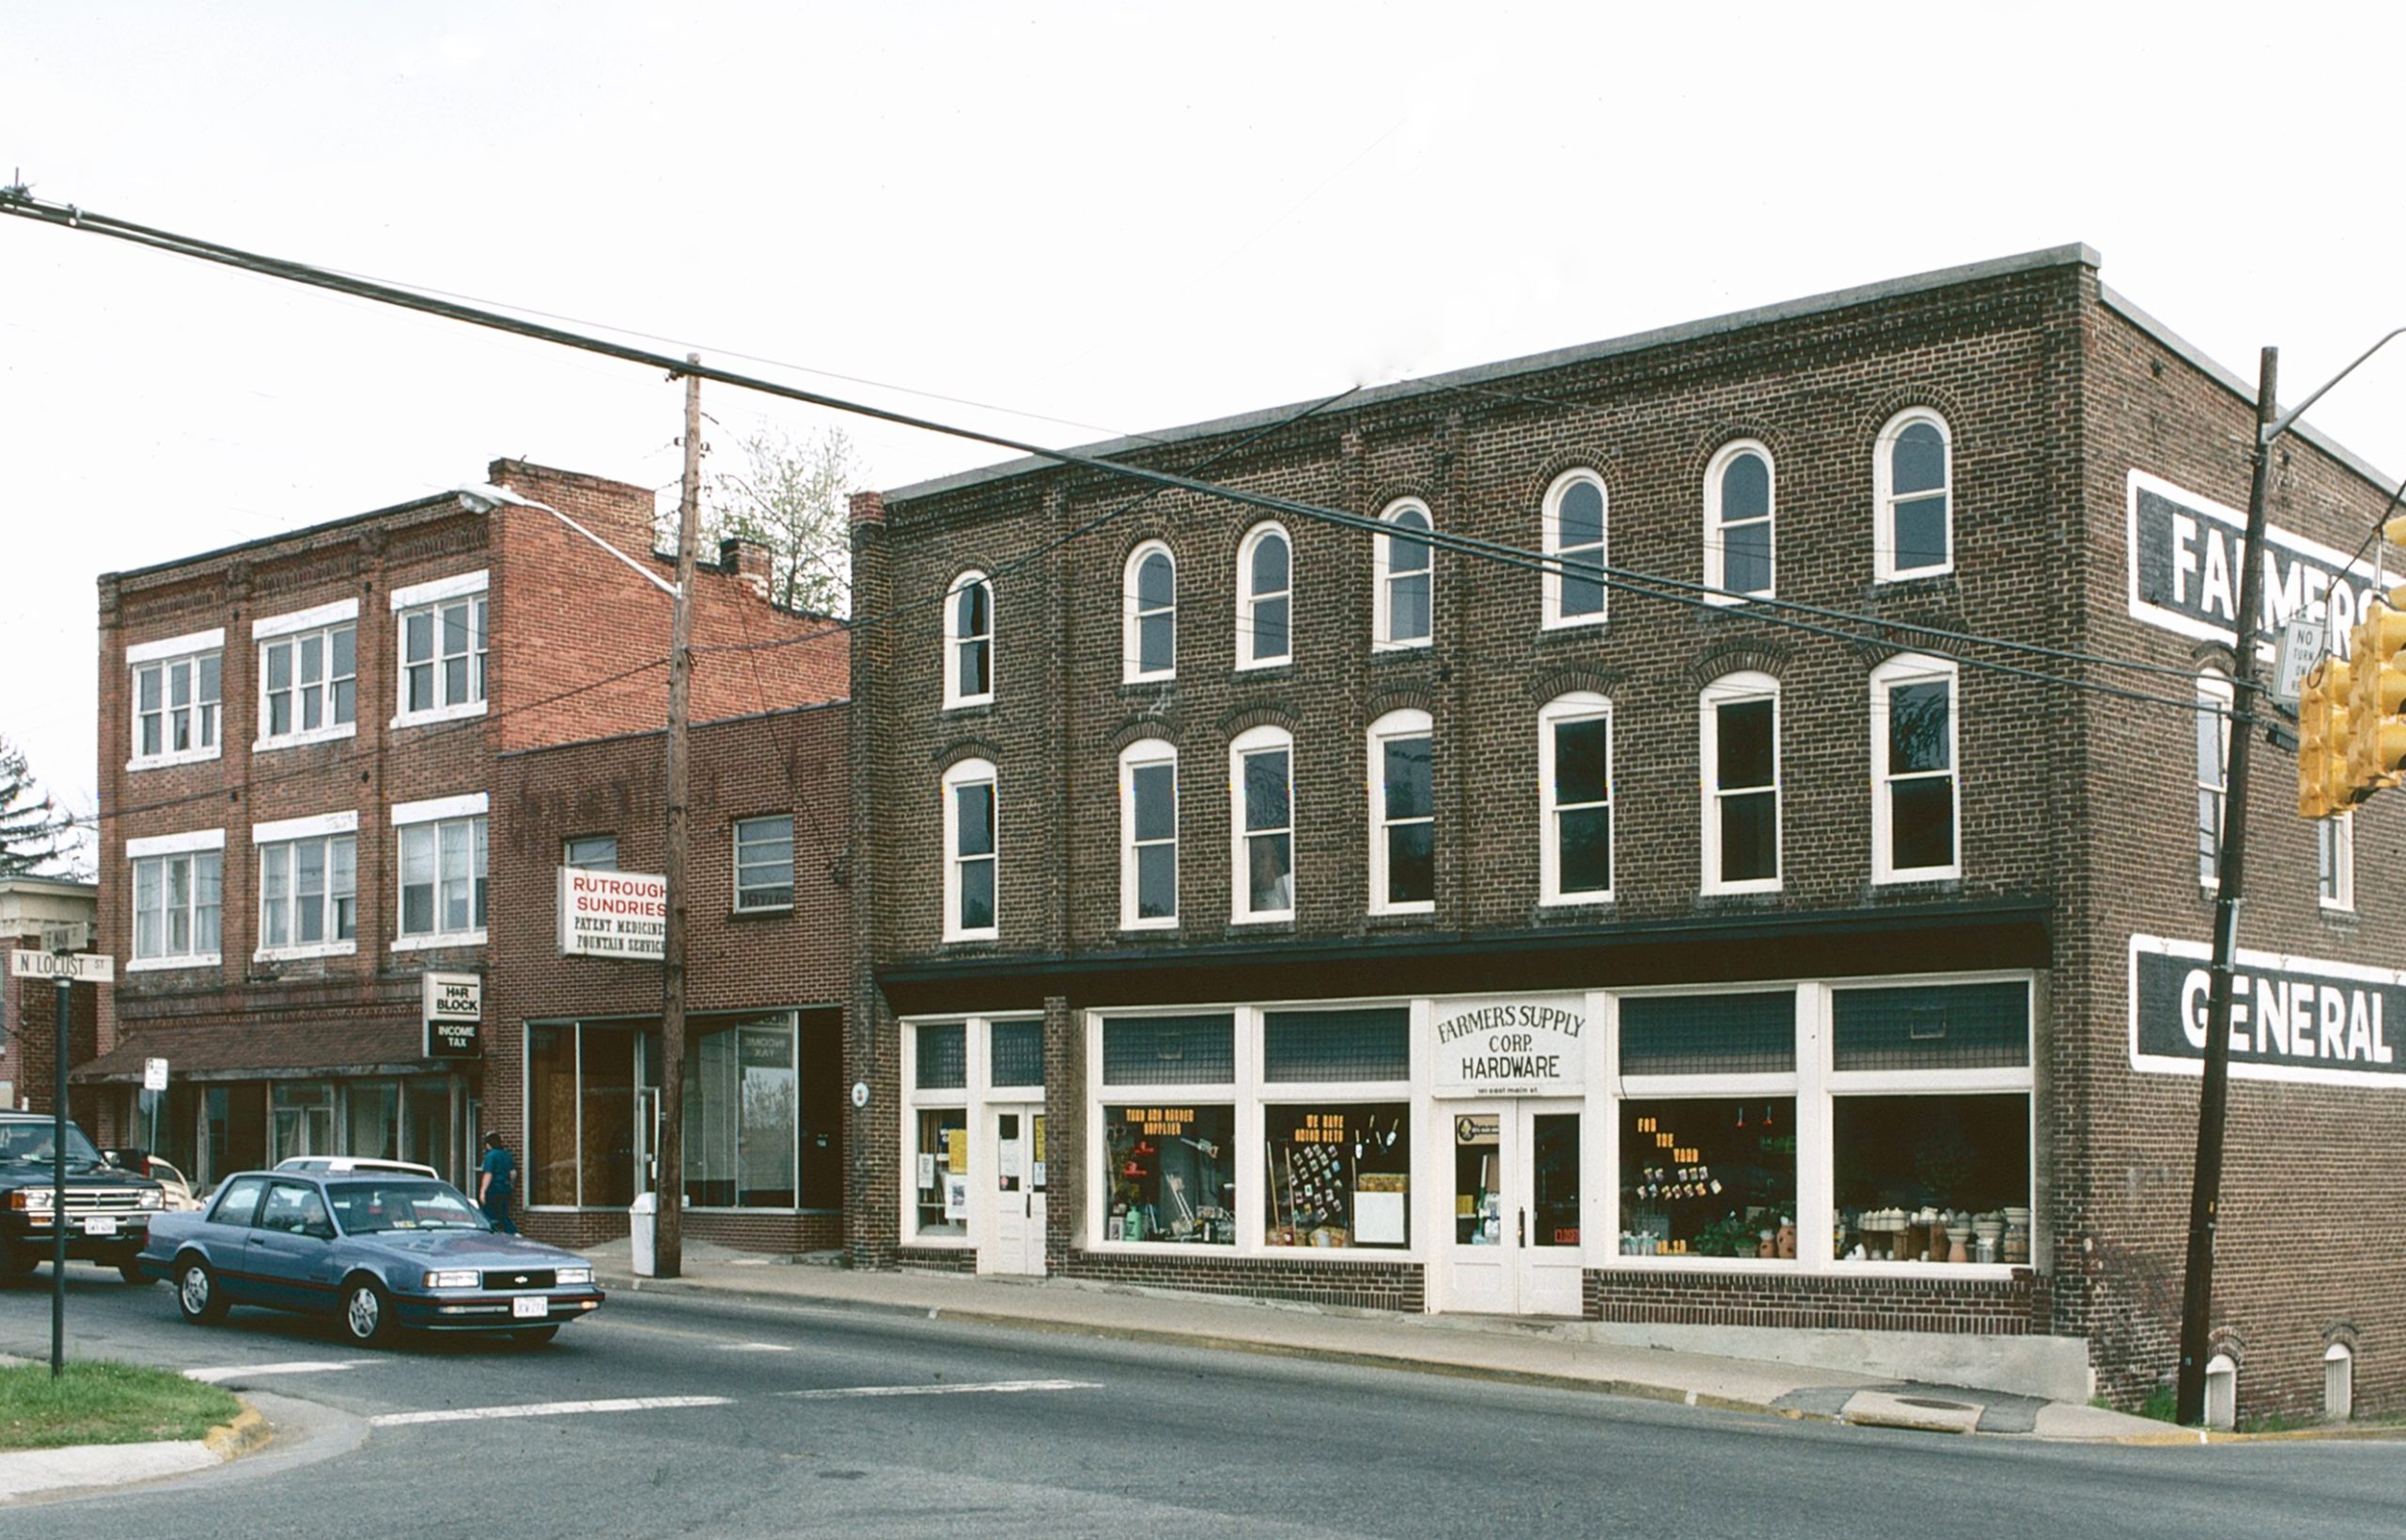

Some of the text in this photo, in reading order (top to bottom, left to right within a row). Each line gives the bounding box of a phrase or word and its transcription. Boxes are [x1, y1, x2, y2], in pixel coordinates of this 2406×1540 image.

[2297, 630, 2313, 646] NO
[2294, 647, 2314, 661] TURN
[2295, 664, 2306, 676] ON
[577, 896, 666, 917] SUNDRIES
[574, 916, 664, 936] PATENT MEDICINE
[577, 935, 624, 951] FOUNTAIN
[21, 954, 104, 975] N LOCUST ST
[446, 987, 469, 999] H&R
[436, 999, 477, 1011] BLOCK
[2181, 969, 2393, 1064] GENERAL
[438, 1025, 477, 1037] INCOME
[1437, 1004, 1586, 1045] FARMERS SUPPLY
[447, 1036, 467, 1048] TAX
[1489, 1034, 1533, 1052] CORP.
[1462, 1055, 1560, 1080] HARDWARE
[1306, 1114, 1344, 1128] WE HAVE
[1638, 1117, 1656, 1133] FOR
[1144, 1122, 1181, 1136] SUPPLIES
[1656, 1133, 1674, 1148] THE
[1674, 1148, 1699, 1163] YARD
